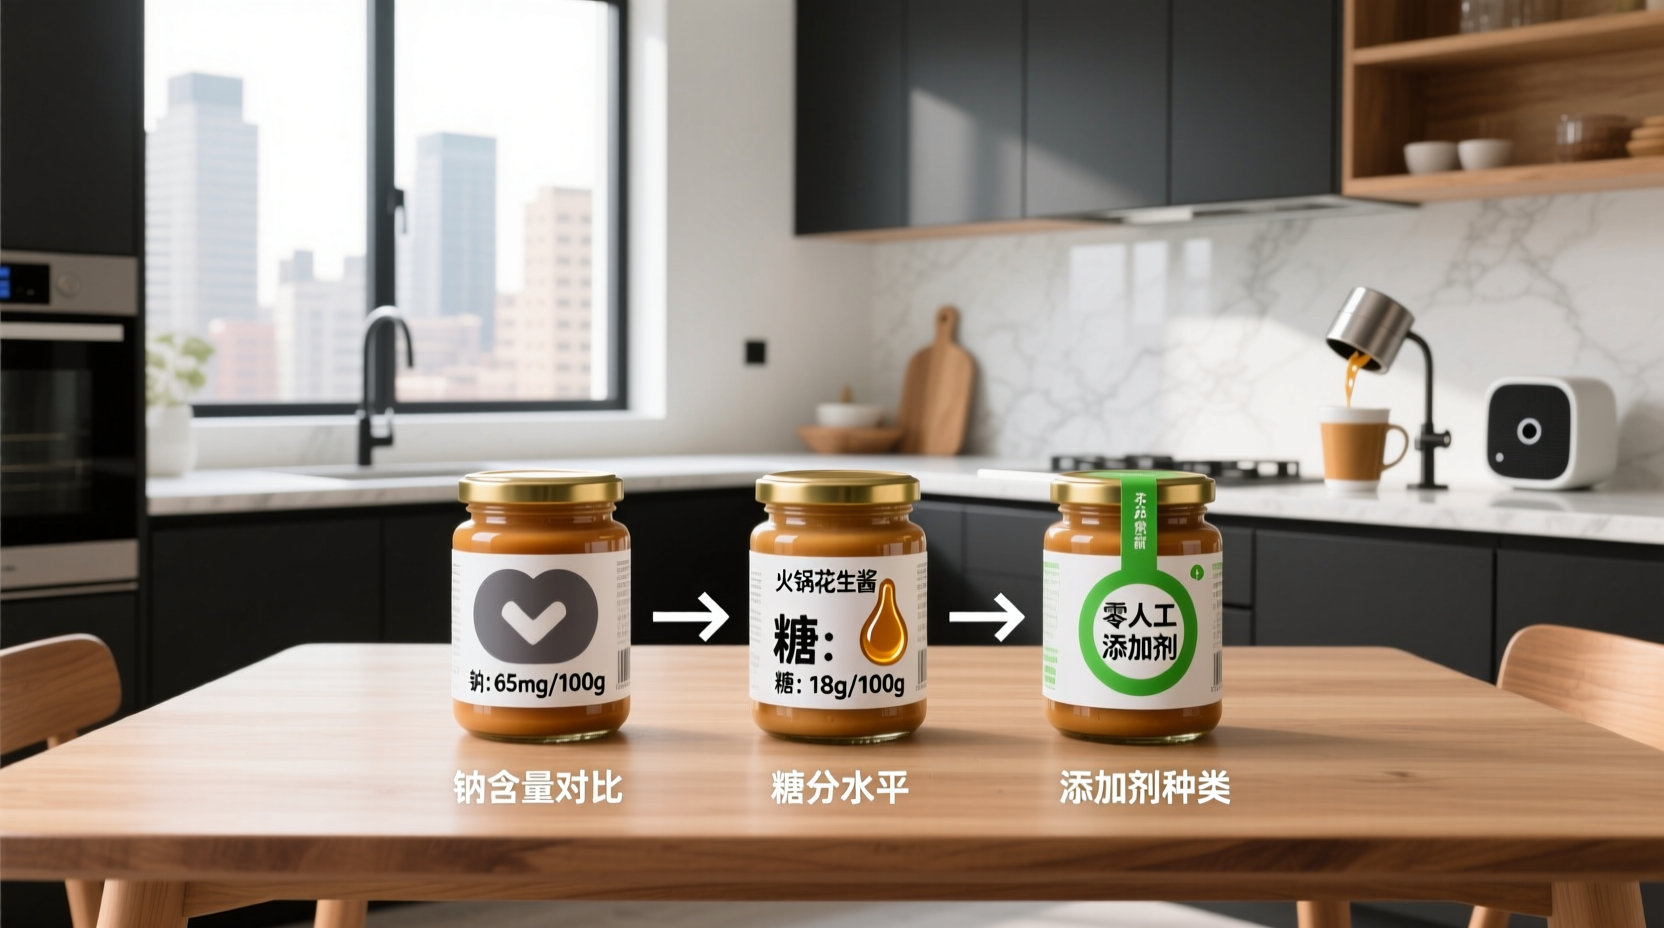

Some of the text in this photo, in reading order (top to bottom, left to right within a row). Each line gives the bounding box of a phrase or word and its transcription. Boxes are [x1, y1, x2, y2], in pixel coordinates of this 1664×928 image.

[775, 568, 878, 594] 火锅花生酱
[1102, 601, 1177, 629] 零人工
[773, 613, 834, 665] 糖:
[1102, 633, 1177, 661] 添加剂
[809, 673, 905, 700] 18g/100g
